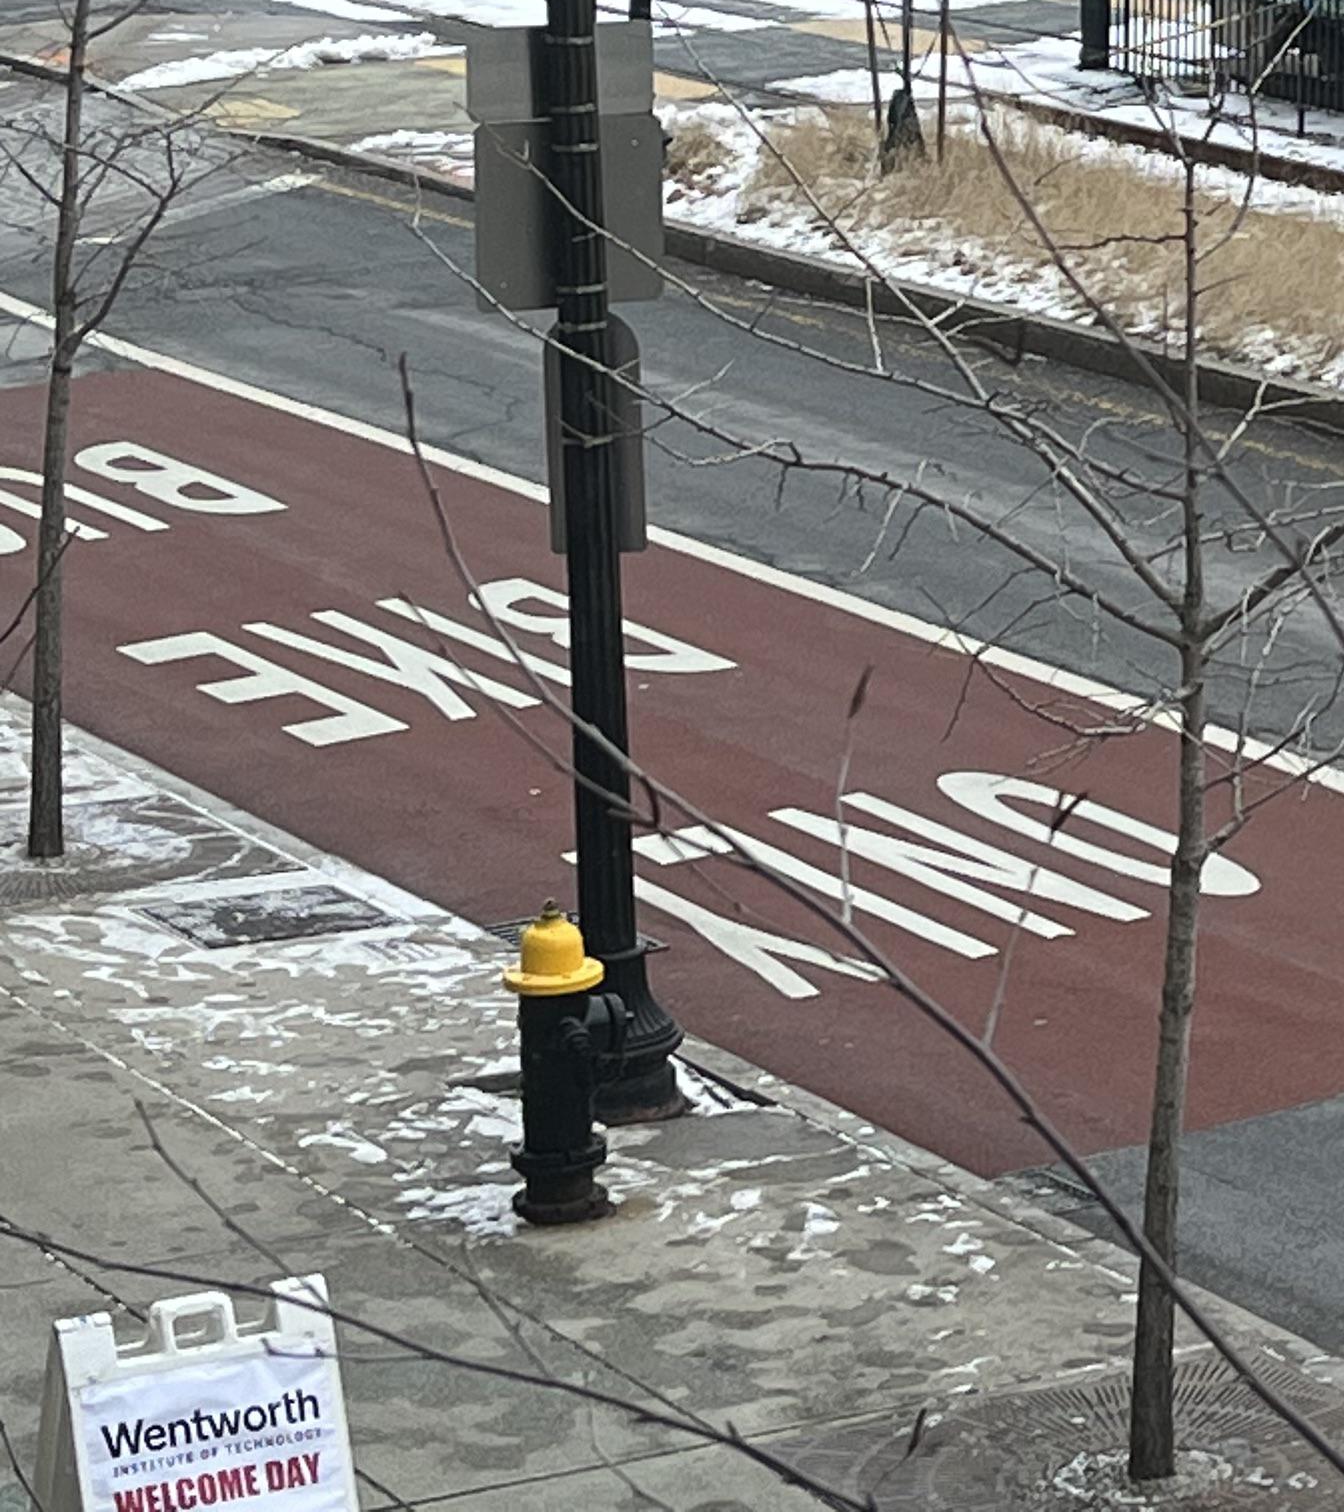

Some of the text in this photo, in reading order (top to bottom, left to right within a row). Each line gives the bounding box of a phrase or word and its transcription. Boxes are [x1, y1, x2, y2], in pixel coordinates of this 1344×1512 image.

[0, 441, 289, 555] BU
[116, 577, 739, 747] BIKE
[560, 771, 1262, 1000] ONLY
[101, 1389, 321, 1458] Wentworth
[113, 1427, 322, 1478] INSTITUTE OF TECHNOLOGY
[113, 1452, 321, 1512] WELCOME DAY
